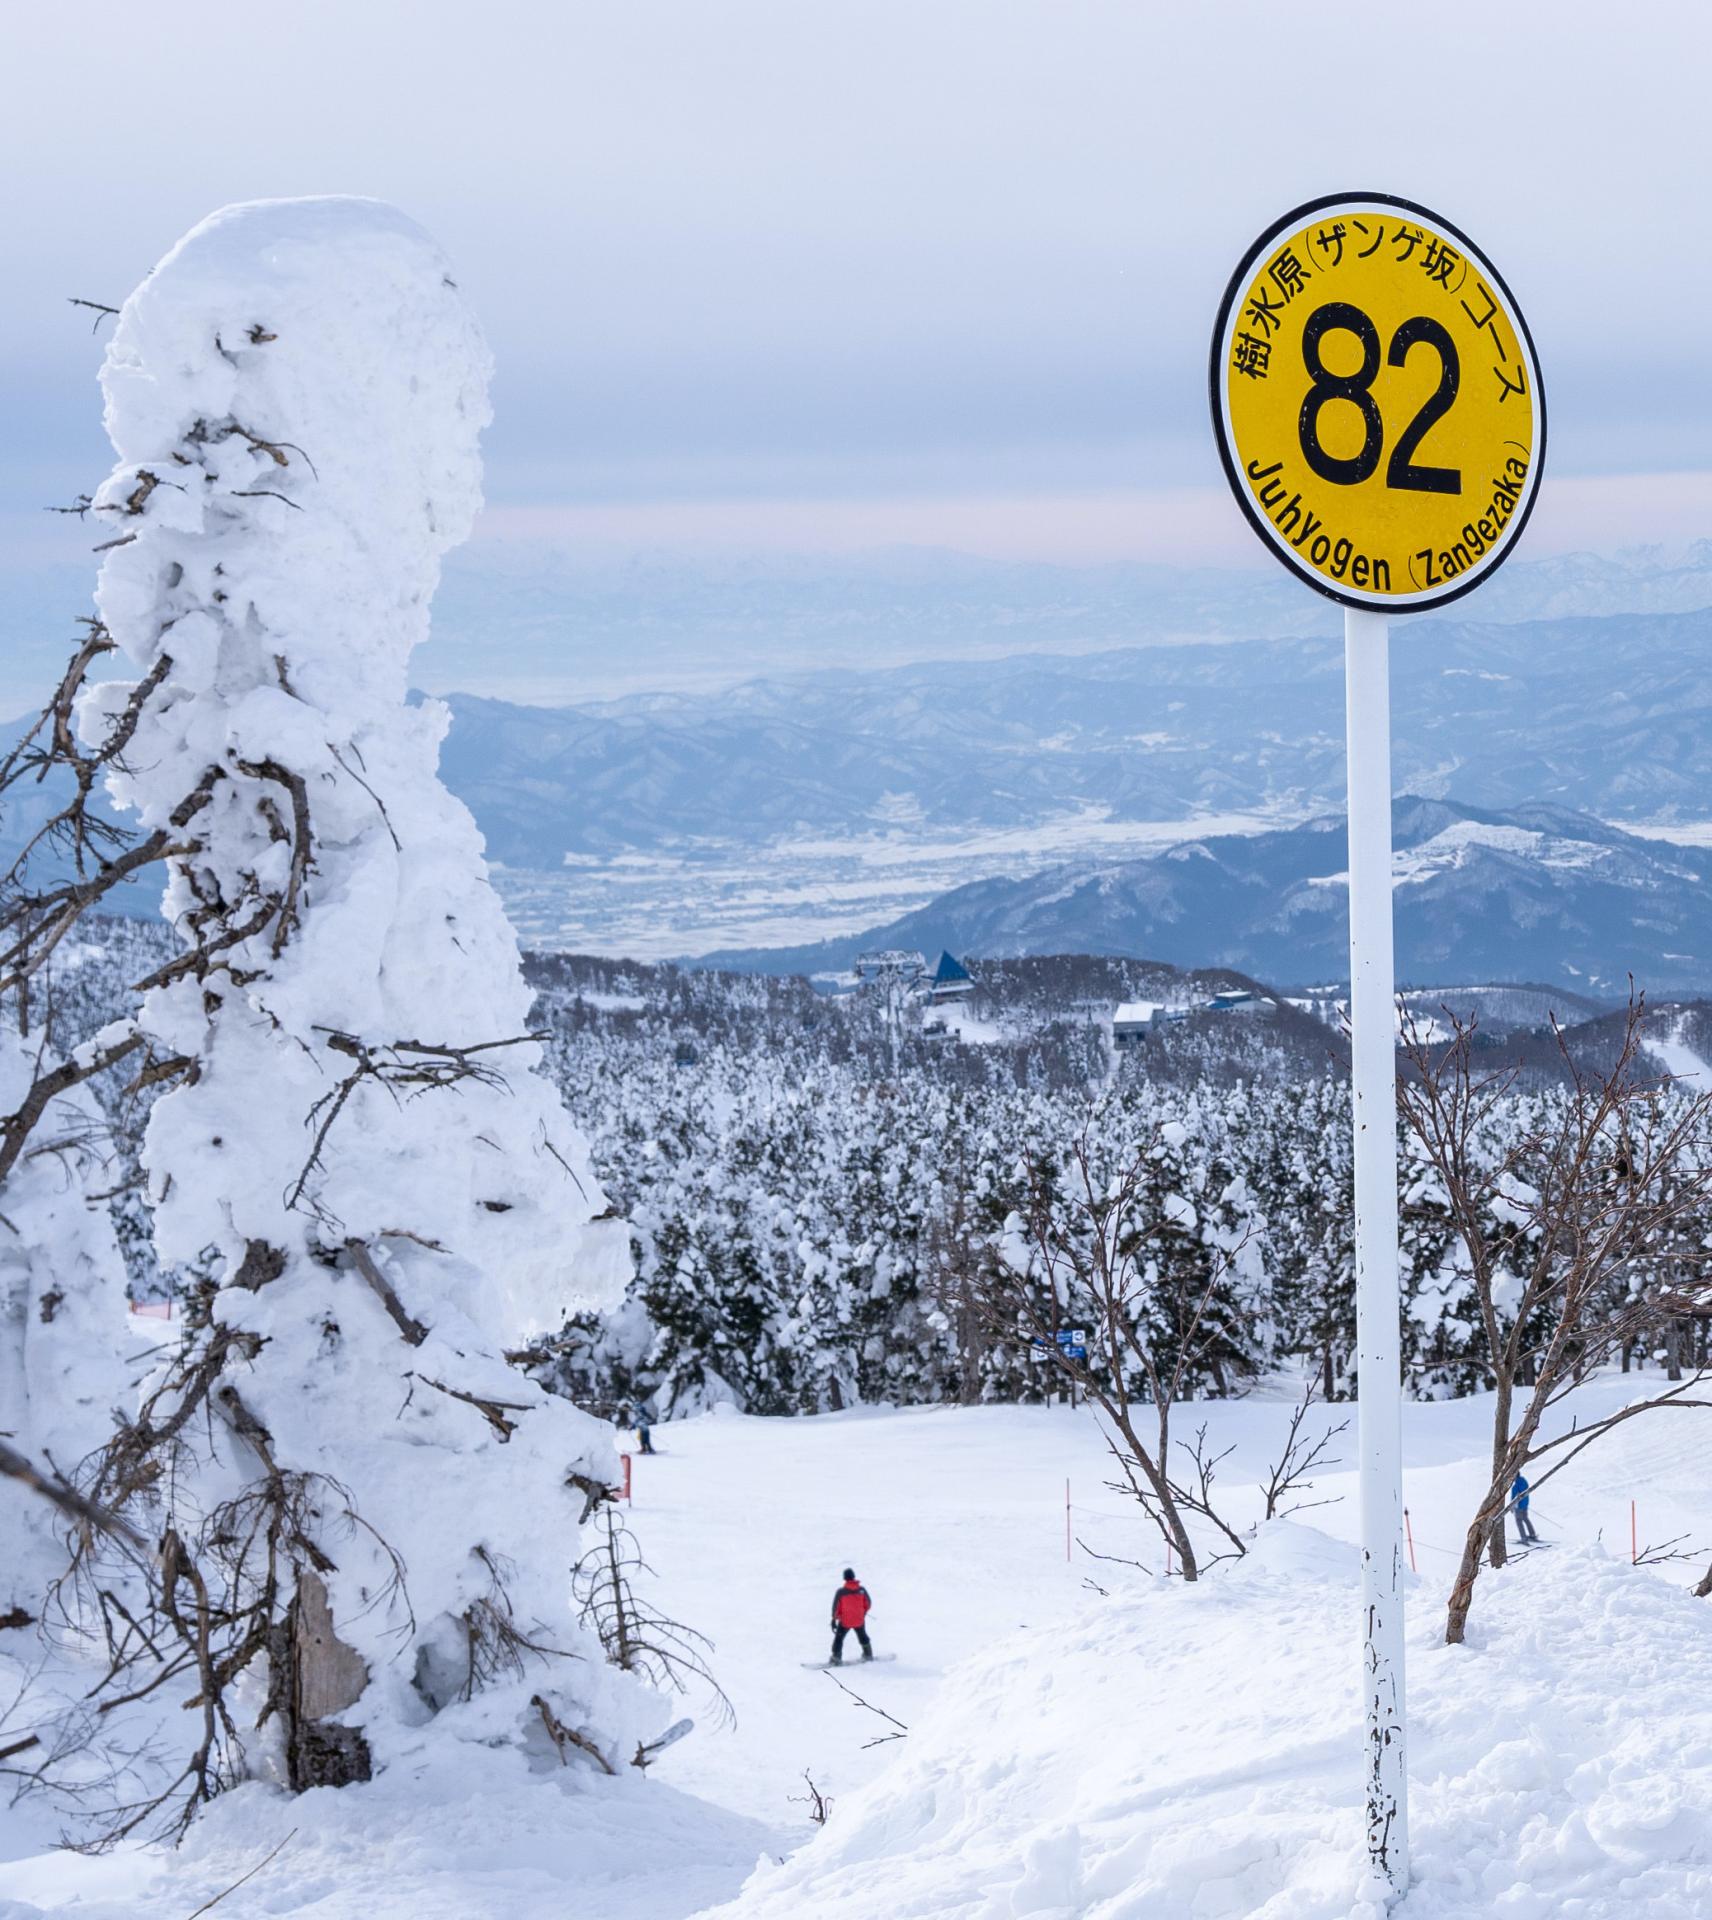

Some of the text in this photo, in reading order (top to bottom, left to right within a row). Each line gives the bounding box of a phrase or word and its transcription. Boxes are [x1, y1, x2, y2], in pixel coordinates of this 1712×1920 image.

[1298, 301, 1462, 495] 82
[1247, 440, 1530, 591] Juhyogen (Zangezaka)
